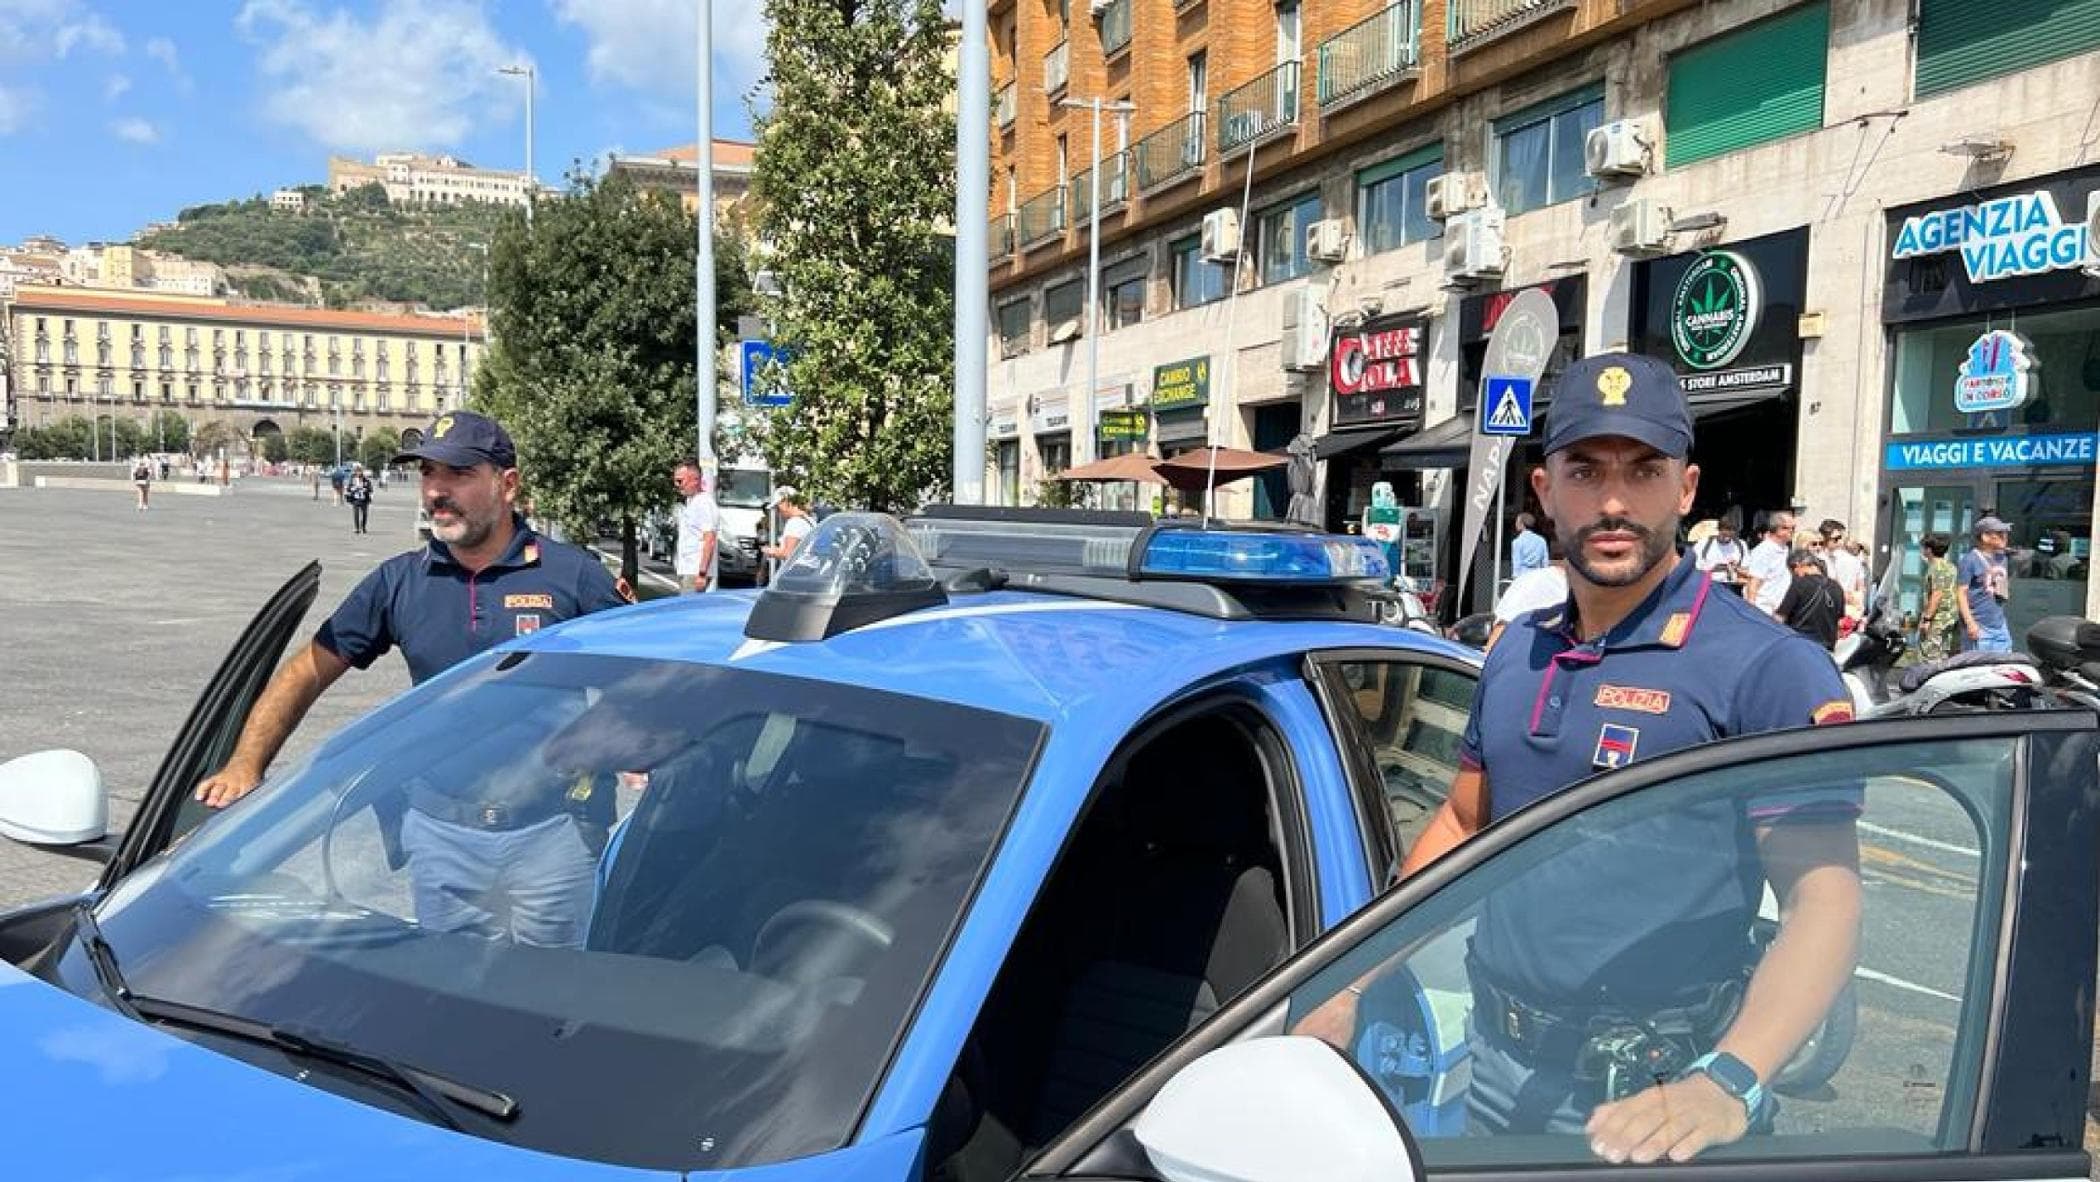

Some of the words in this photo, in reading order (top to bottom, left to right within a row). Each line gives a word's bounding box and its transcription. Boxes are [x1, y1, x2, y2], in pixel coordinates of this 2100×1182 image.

[1898, 194, 2050, 254] AGENZIA
[1964, 226, 2087, 280] VIAGGI
[1718, 367, 1780, 387] AMSTERDAM
[1902, 442, 1967, 465] VIAGGI
[1974, 442, 1985, 463] E
[1989, 438, 2092, 461] VACANZE
[1599, 687, 1666, 711] POLIZIA
